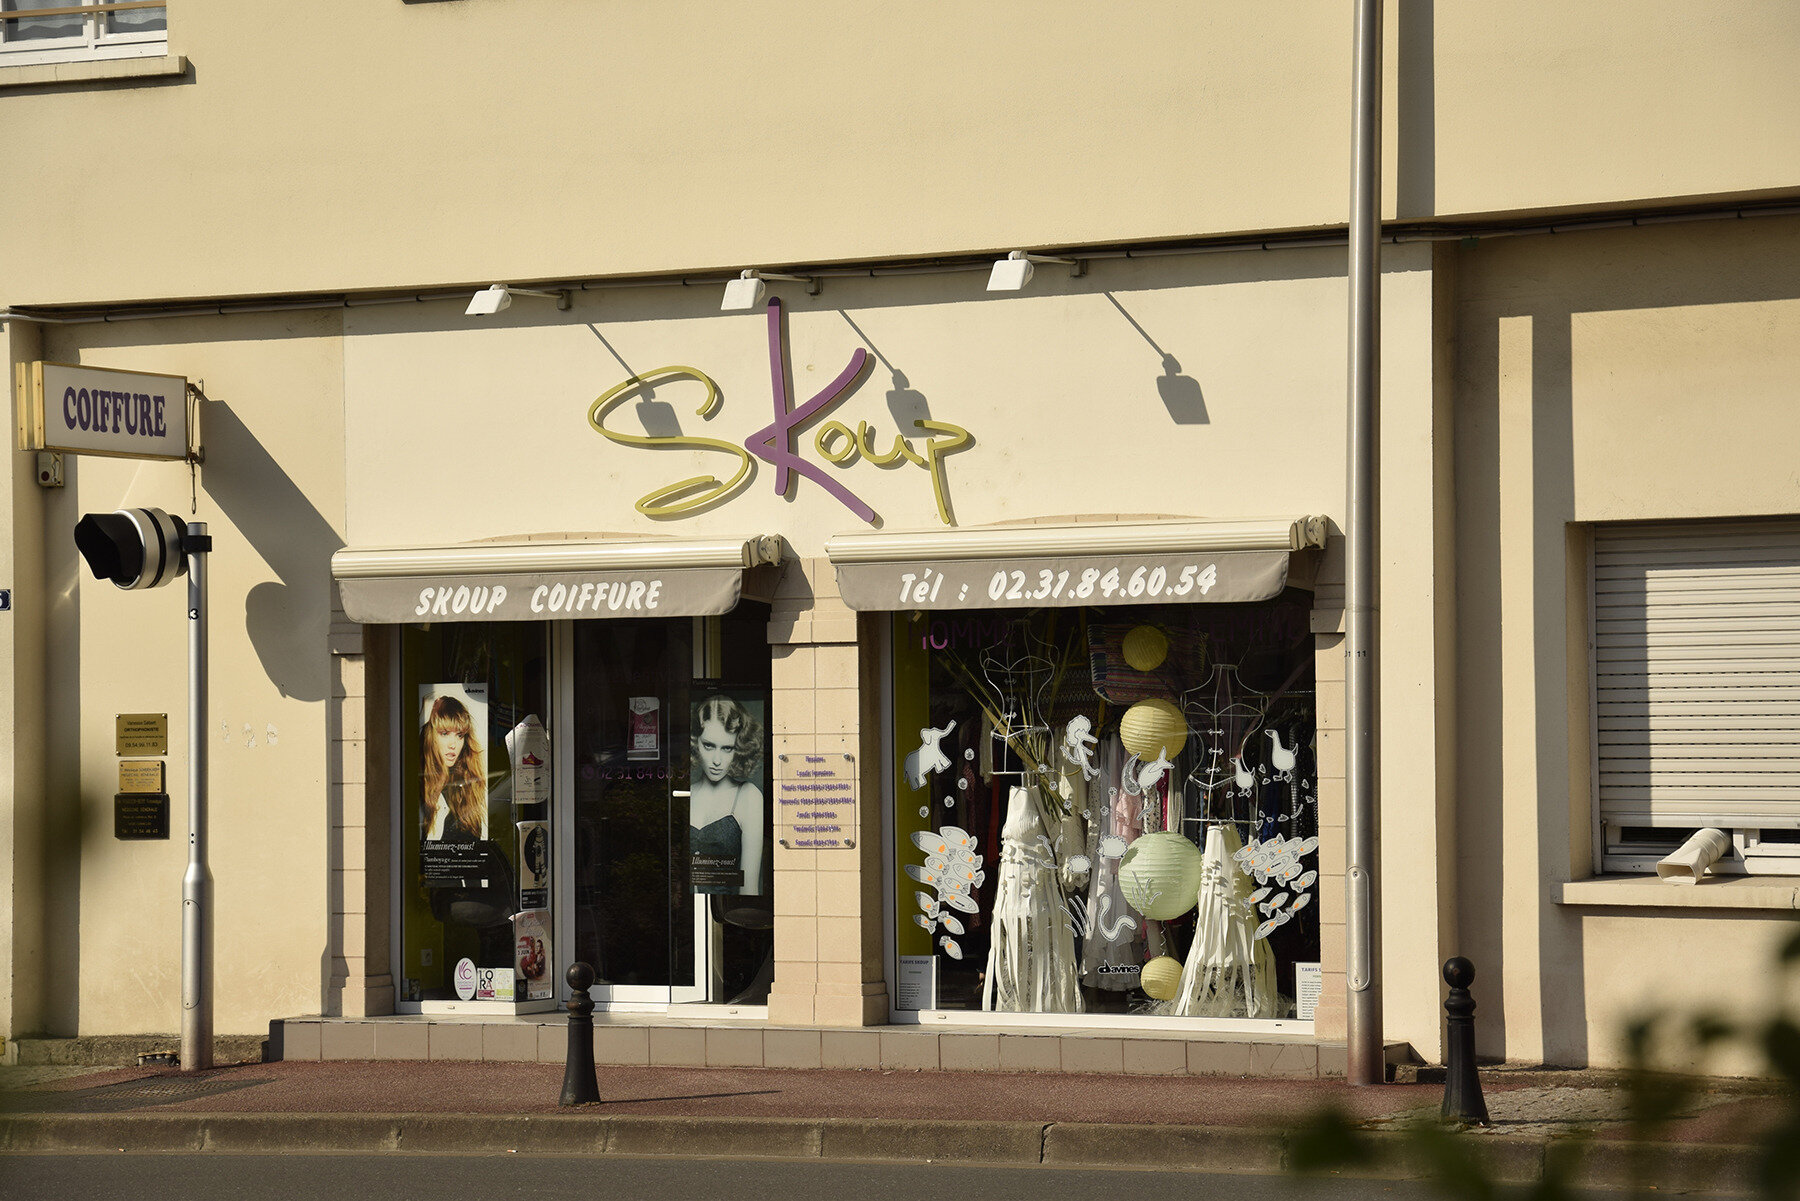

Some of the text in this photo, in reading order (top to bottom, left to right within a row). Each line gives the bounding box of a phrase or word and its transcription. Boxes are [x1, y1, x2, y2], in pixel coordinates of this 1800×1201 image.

[63, 386, 166, 437] COIFFURE
[415, 580, 662, 615] SKOUP COIFFURE
[900, 567, 944, 602] Tél
[988, 564, 1217, 600] 02.31.84.60.54
[1098, 960, 1140, 973] davines
